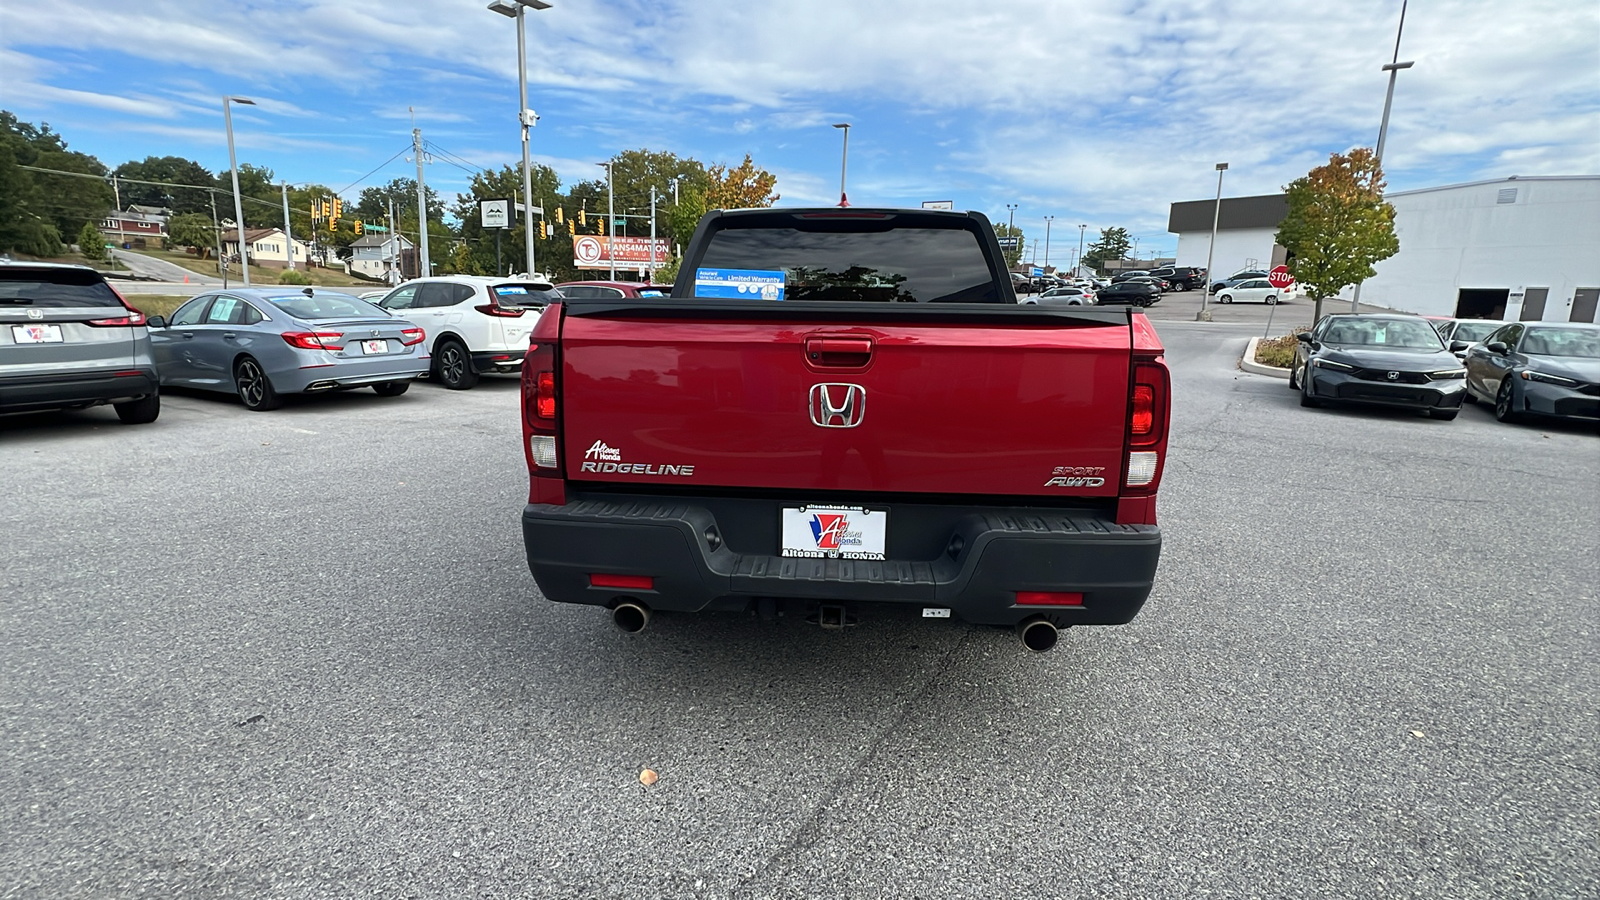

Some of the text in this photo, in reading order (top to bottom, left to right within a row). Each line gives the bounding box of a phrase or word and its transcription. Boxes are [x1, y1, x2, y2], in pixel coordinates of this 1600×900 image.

[751, 276, 781, 284] Warranty
[1270, 272, 1294, 282] STOP
[600, 453, 621, 461] Honda
[581, 462, 695, 476] RIDGELINE
[1052, 466, 1105, 475] SPORT
[1043, 477, 1105, 487] AWD
[835, 537, 862, 546] Honda
[782, 549, 825, 558] Altoona
